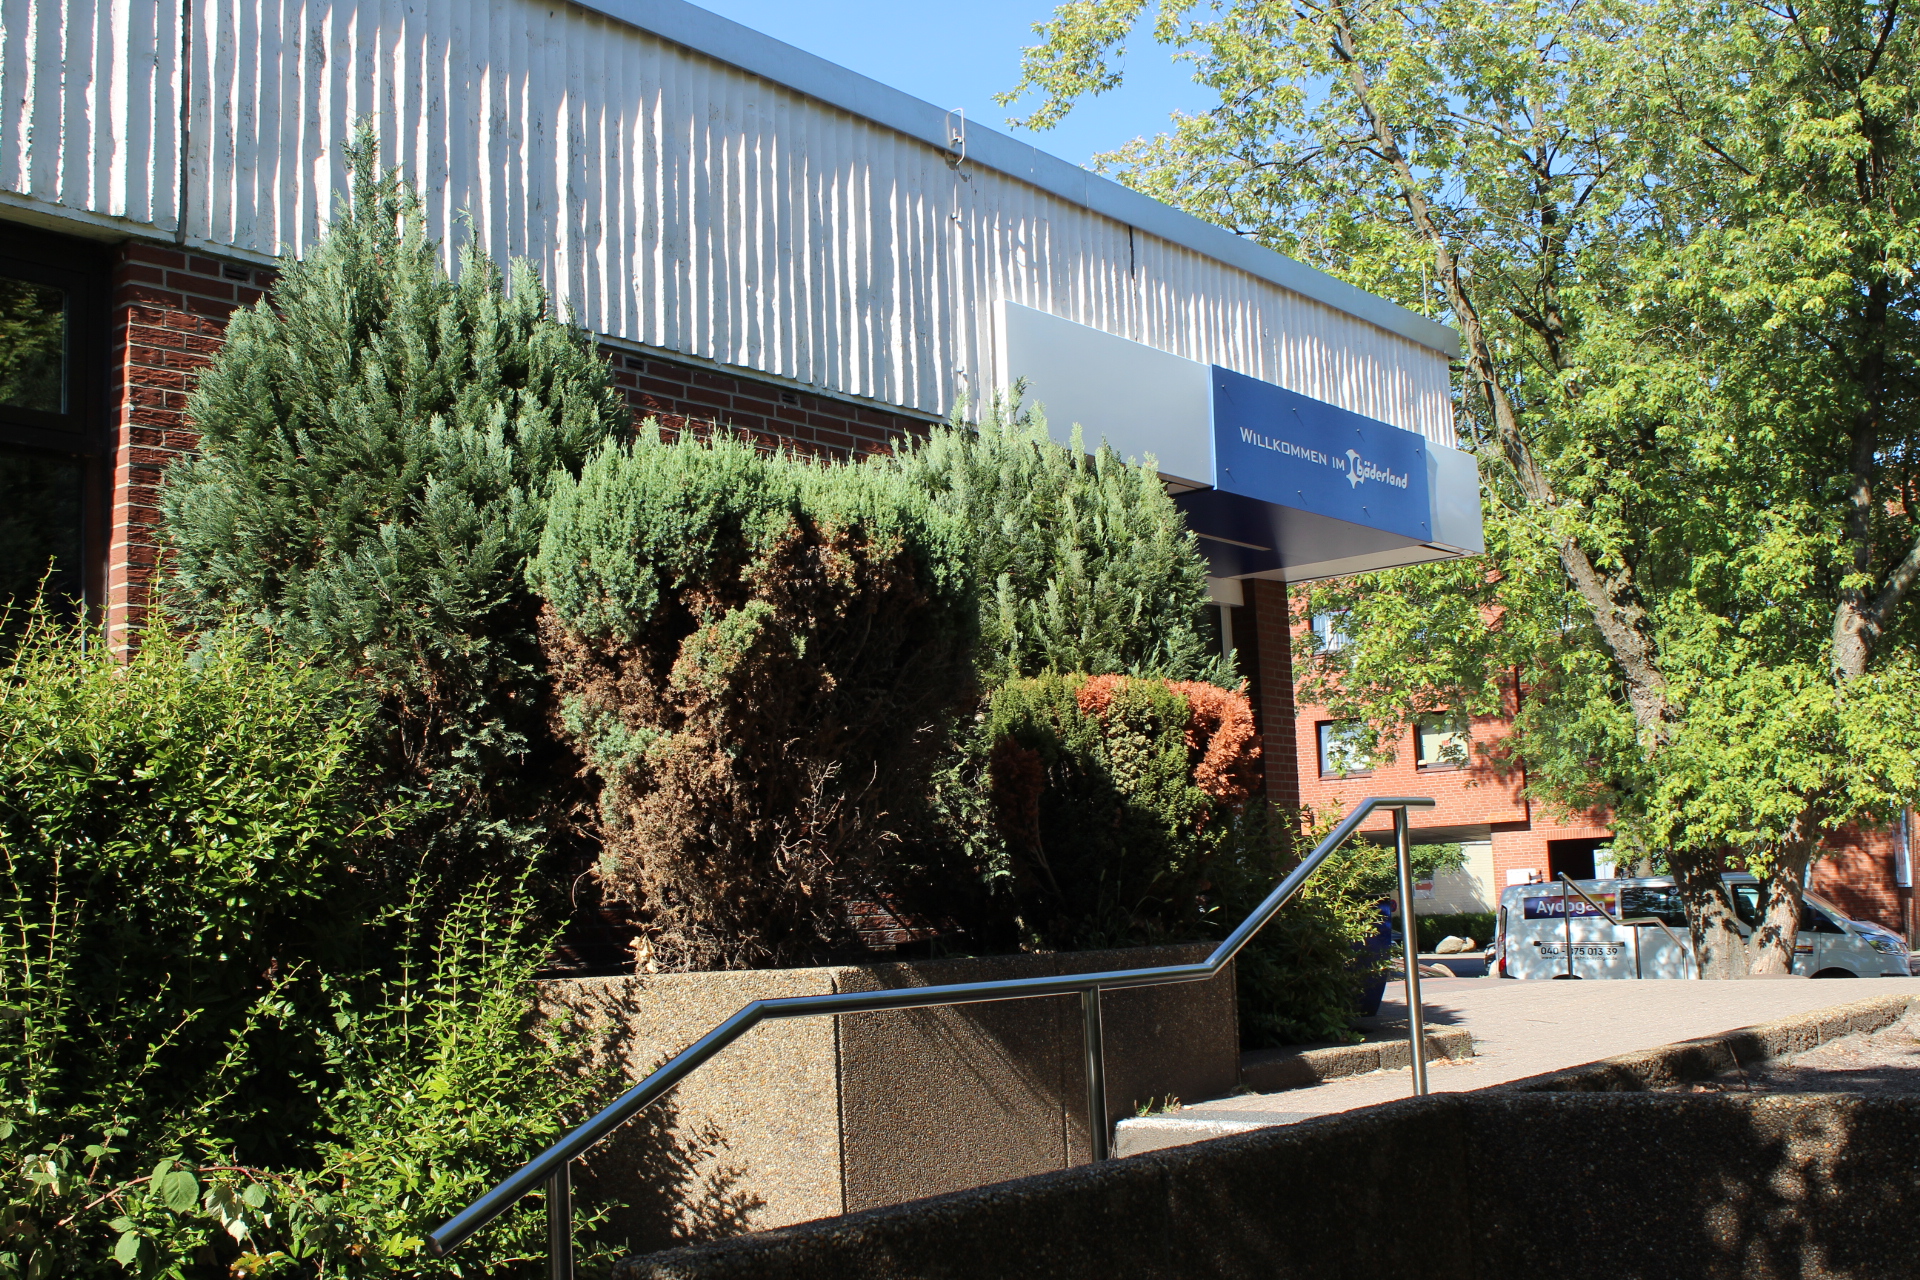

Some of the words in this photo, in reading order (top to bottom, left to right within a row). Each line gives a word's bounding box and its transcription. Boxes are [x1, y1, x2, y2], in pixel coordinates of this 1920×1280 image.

[1356, 460, 1408, 489] bäderland
[1536, 899, 1605, 916] Aydogan
[1540, 947, 1559, 955] 040
[1587, 947, 1604, 956] 013
[1606, 947, 1618, 956] 39
